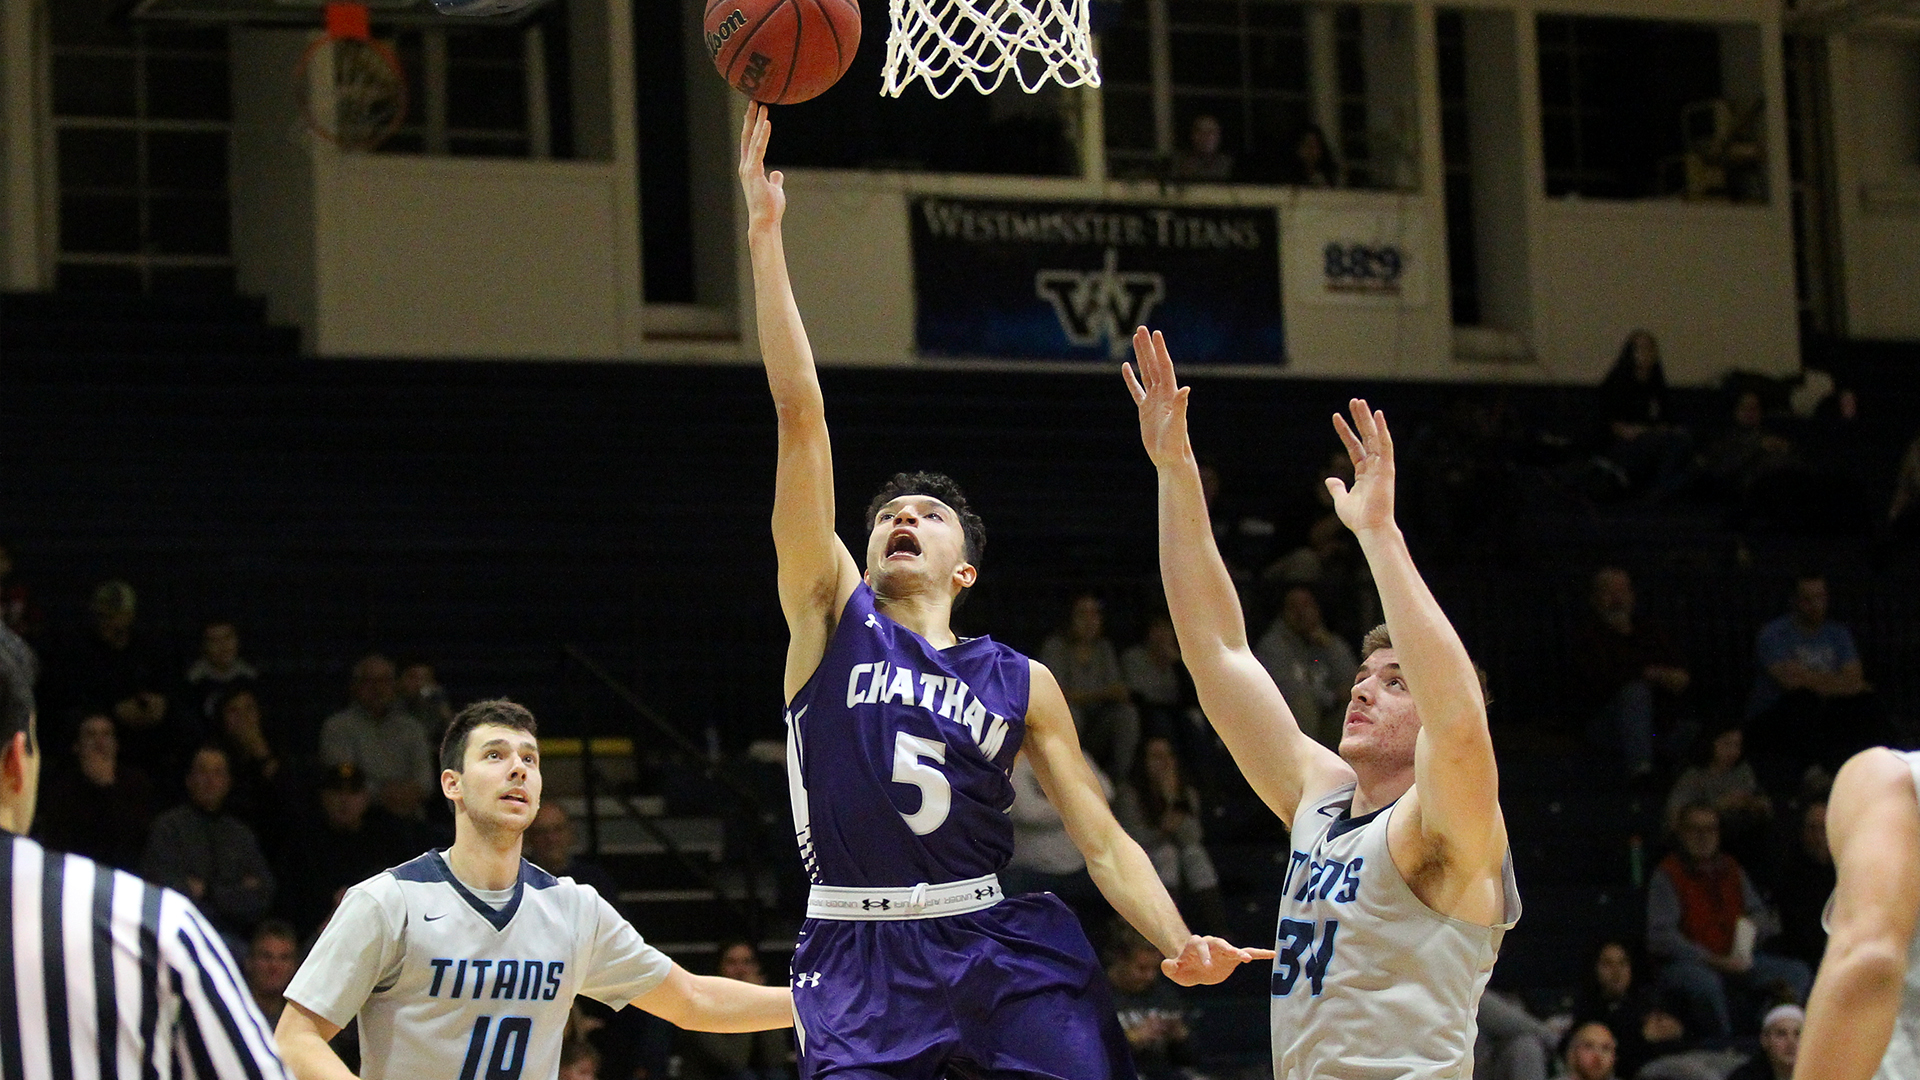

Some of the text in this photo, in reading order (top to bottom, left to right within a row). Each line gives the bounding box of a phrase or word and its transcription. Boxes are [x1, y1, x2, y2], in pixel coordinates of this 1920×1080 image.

[736, 51, 771, 93] CAA
[846, 660, 1010, 762] CHATHAM
[891, 731, 952, 836] 5
[1283, 849, 1364, 904] TANS
[428, 958, 565, 1001] TITANS
[1271, 917, 1339, 998] 34
[459, 1015, 533, 1080] 10
